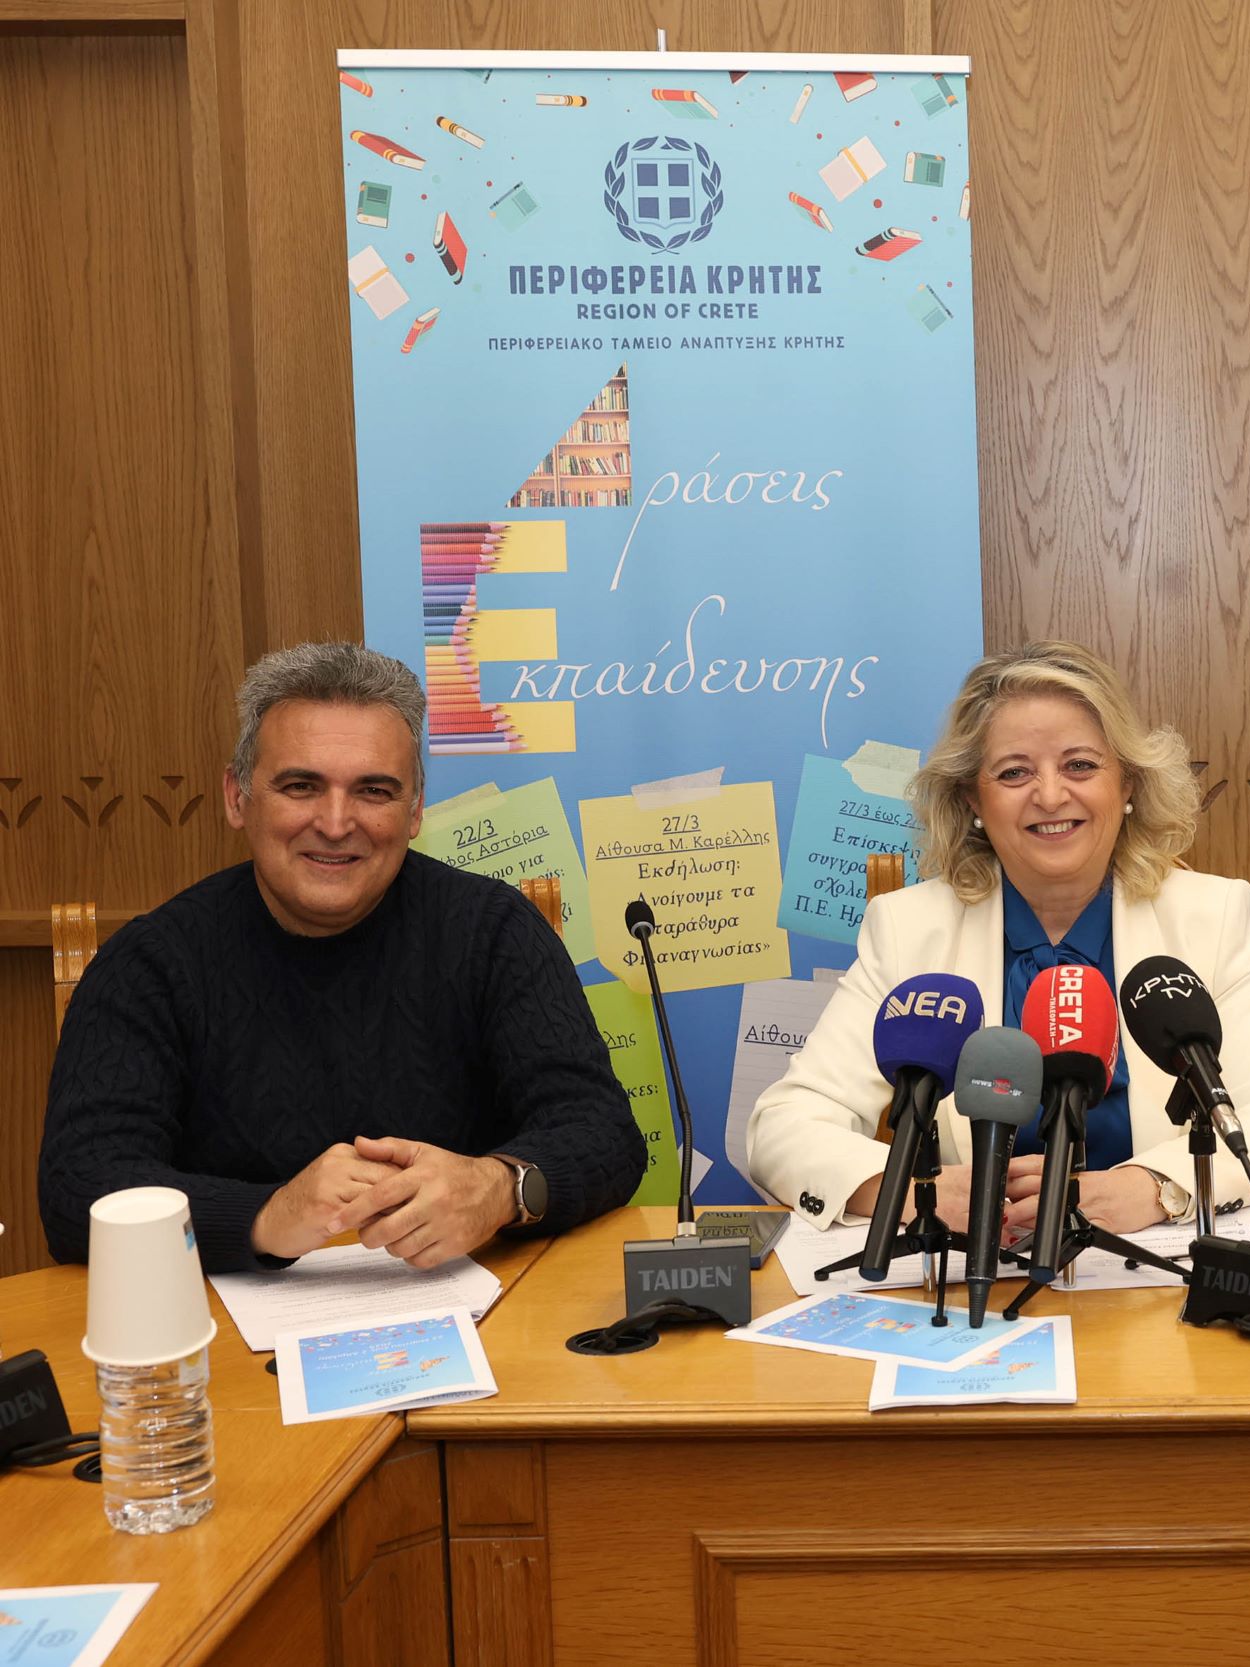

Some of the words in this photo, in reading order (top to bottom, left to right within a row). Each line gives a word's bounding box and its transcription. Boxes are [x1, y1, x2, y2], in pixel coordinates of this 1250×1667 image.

[509, 265, 697, 295] ΠΕΡΙΦΕΡΕΙΑ
[707, 265, 822, 295] ΚΡΗΤΗΣ
[577, 303, 659, 320] REGION
[665, 303, 693, 320] OF
[698, 303, 759, 319] CRETE
[488, 337, 604, 351] ΠΕΡΙΦΕΡΕΙΑΚΟ
[611, 337, 673, 350] ΤΑΜΕΙΟ
[680, 336, 777, 350] ΑΝΑΠΤΥΞΗΣ
[784, 336, 846, 350] ΚΡΗΤΗΣ
[662, 814, 701, 834] 27/3
[839, 800, 870, 817] 27/3
[875, 806, 900, 825] έως
[453, 818, 498, 848] 22/3
[478, 825, 549, 858] Αστόρια
[595, 840, 665, 860] Αίθουσα
[669, 838, 689, 850] Μ.
[693, 828, 770, 850] Καρέλλης
[518, 853, 545, 873] για
[638, 857, 741, 881] Εκδήλωση:
[808, 851, 868, 875] συγγρα
[731, 885, 756, 899] τα
[1160, 986, 1193, 999] TV
[1058, 966, 1084, 1046] CRETA
[638, 1265, 732, 1292] TAIDEN
